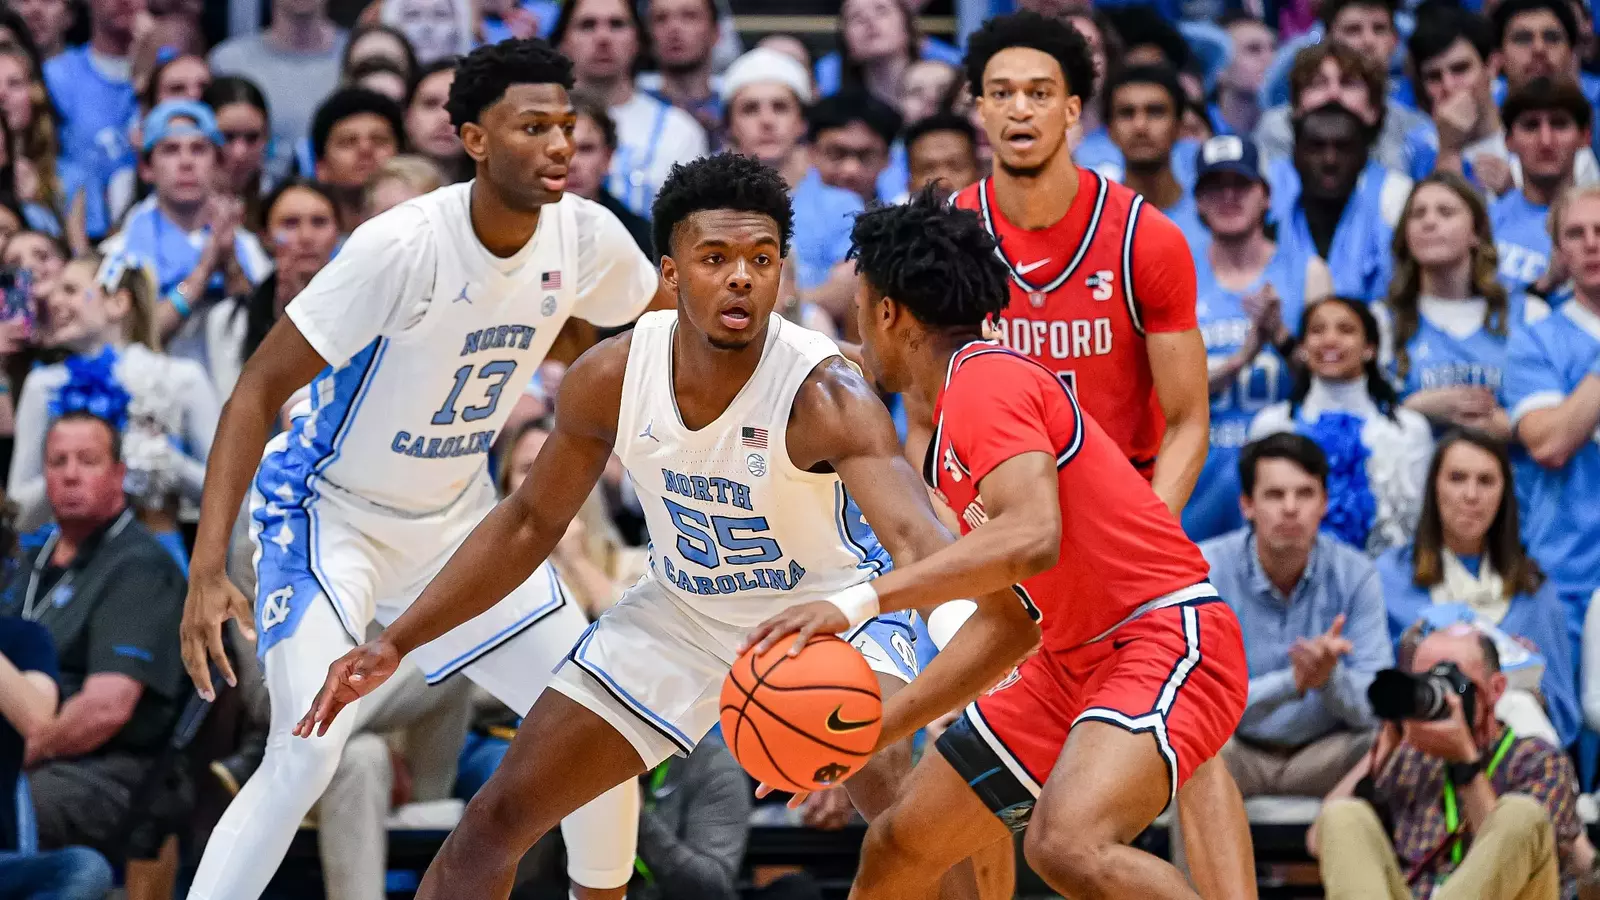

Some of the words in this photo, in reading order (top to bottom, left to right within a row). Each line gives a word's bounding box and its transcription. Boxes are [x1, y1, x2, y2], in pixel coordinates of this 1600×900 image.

[459, 324, 536, 357] NORTH
[430, 359, 518, 426] 13
[661, 468, 754, 512] NORTH
[660, 495, 784, 570] 55
[663, 555, 806, 596] CAROLINA
